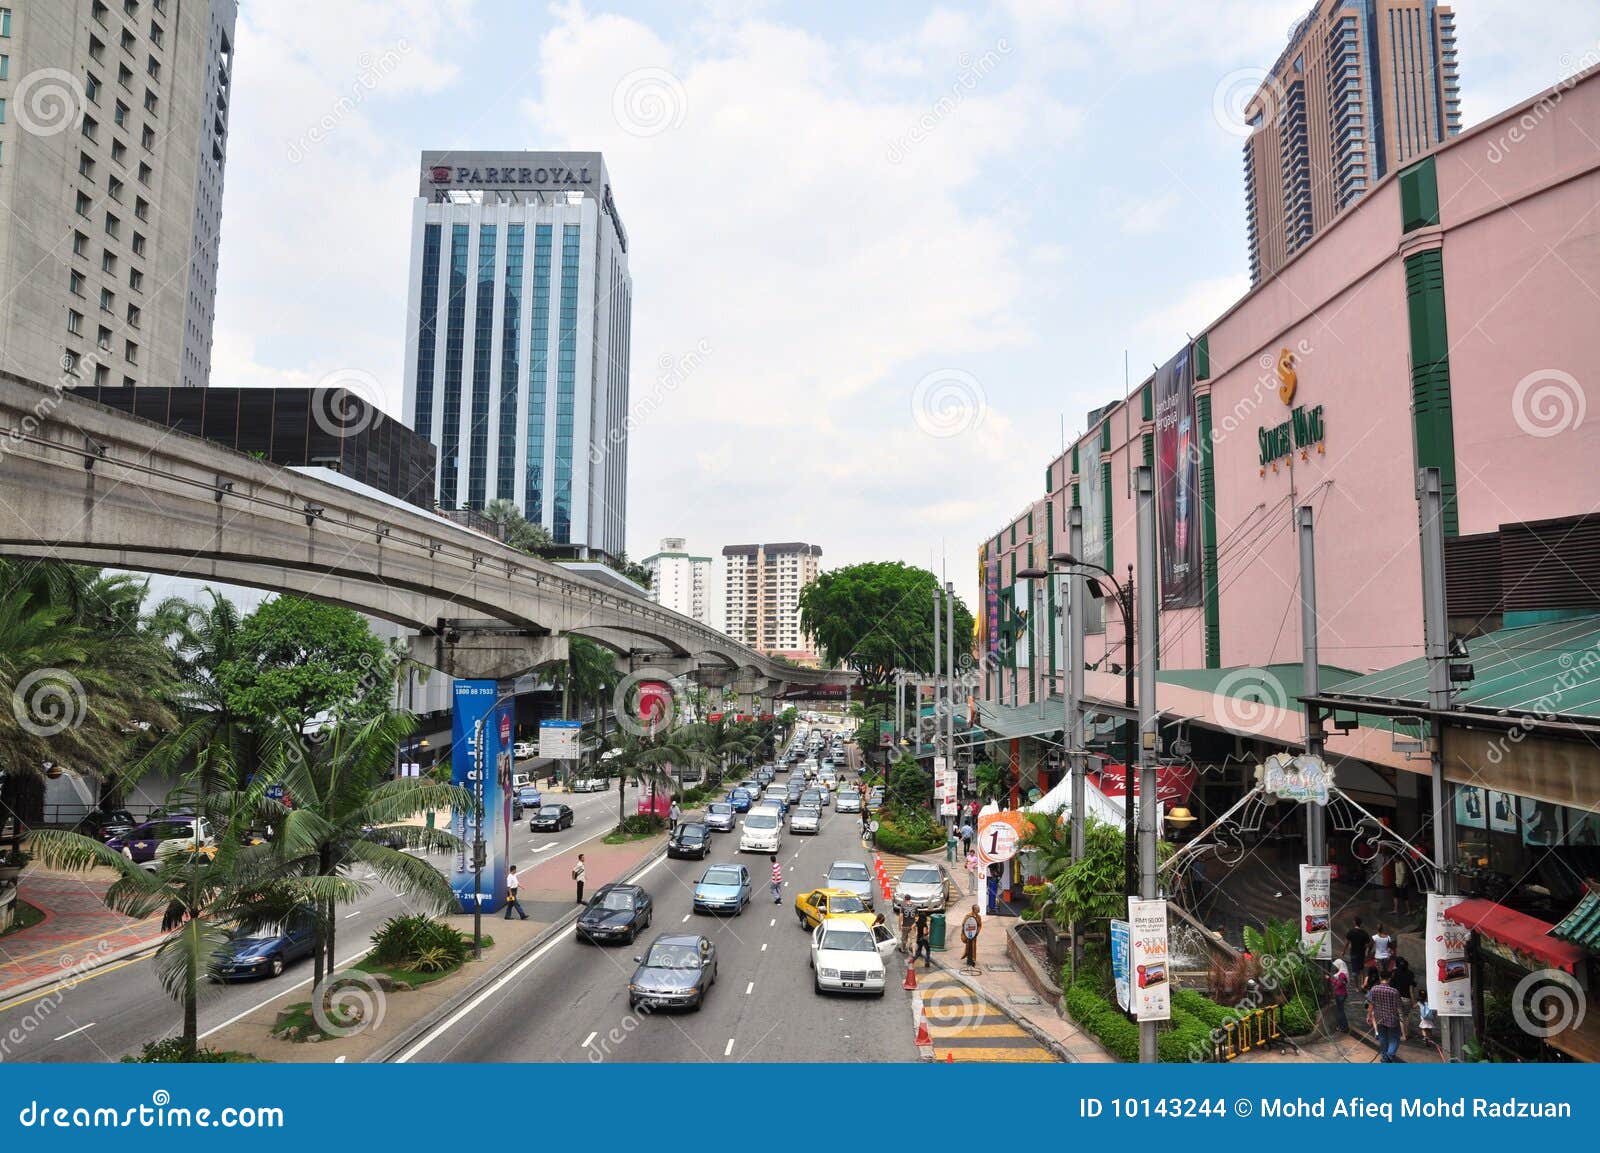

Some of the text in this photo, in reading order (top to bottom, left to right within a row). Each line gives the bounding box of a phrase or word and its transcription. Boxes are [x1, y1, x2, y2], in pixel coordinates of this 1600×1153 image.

[456, 167, 592, 184] PARKROYAL
[1292, 405, 1324, 449] WANG
[988, 830, 998, 854] 1
[1144, 944, 1167, 954] WIN
